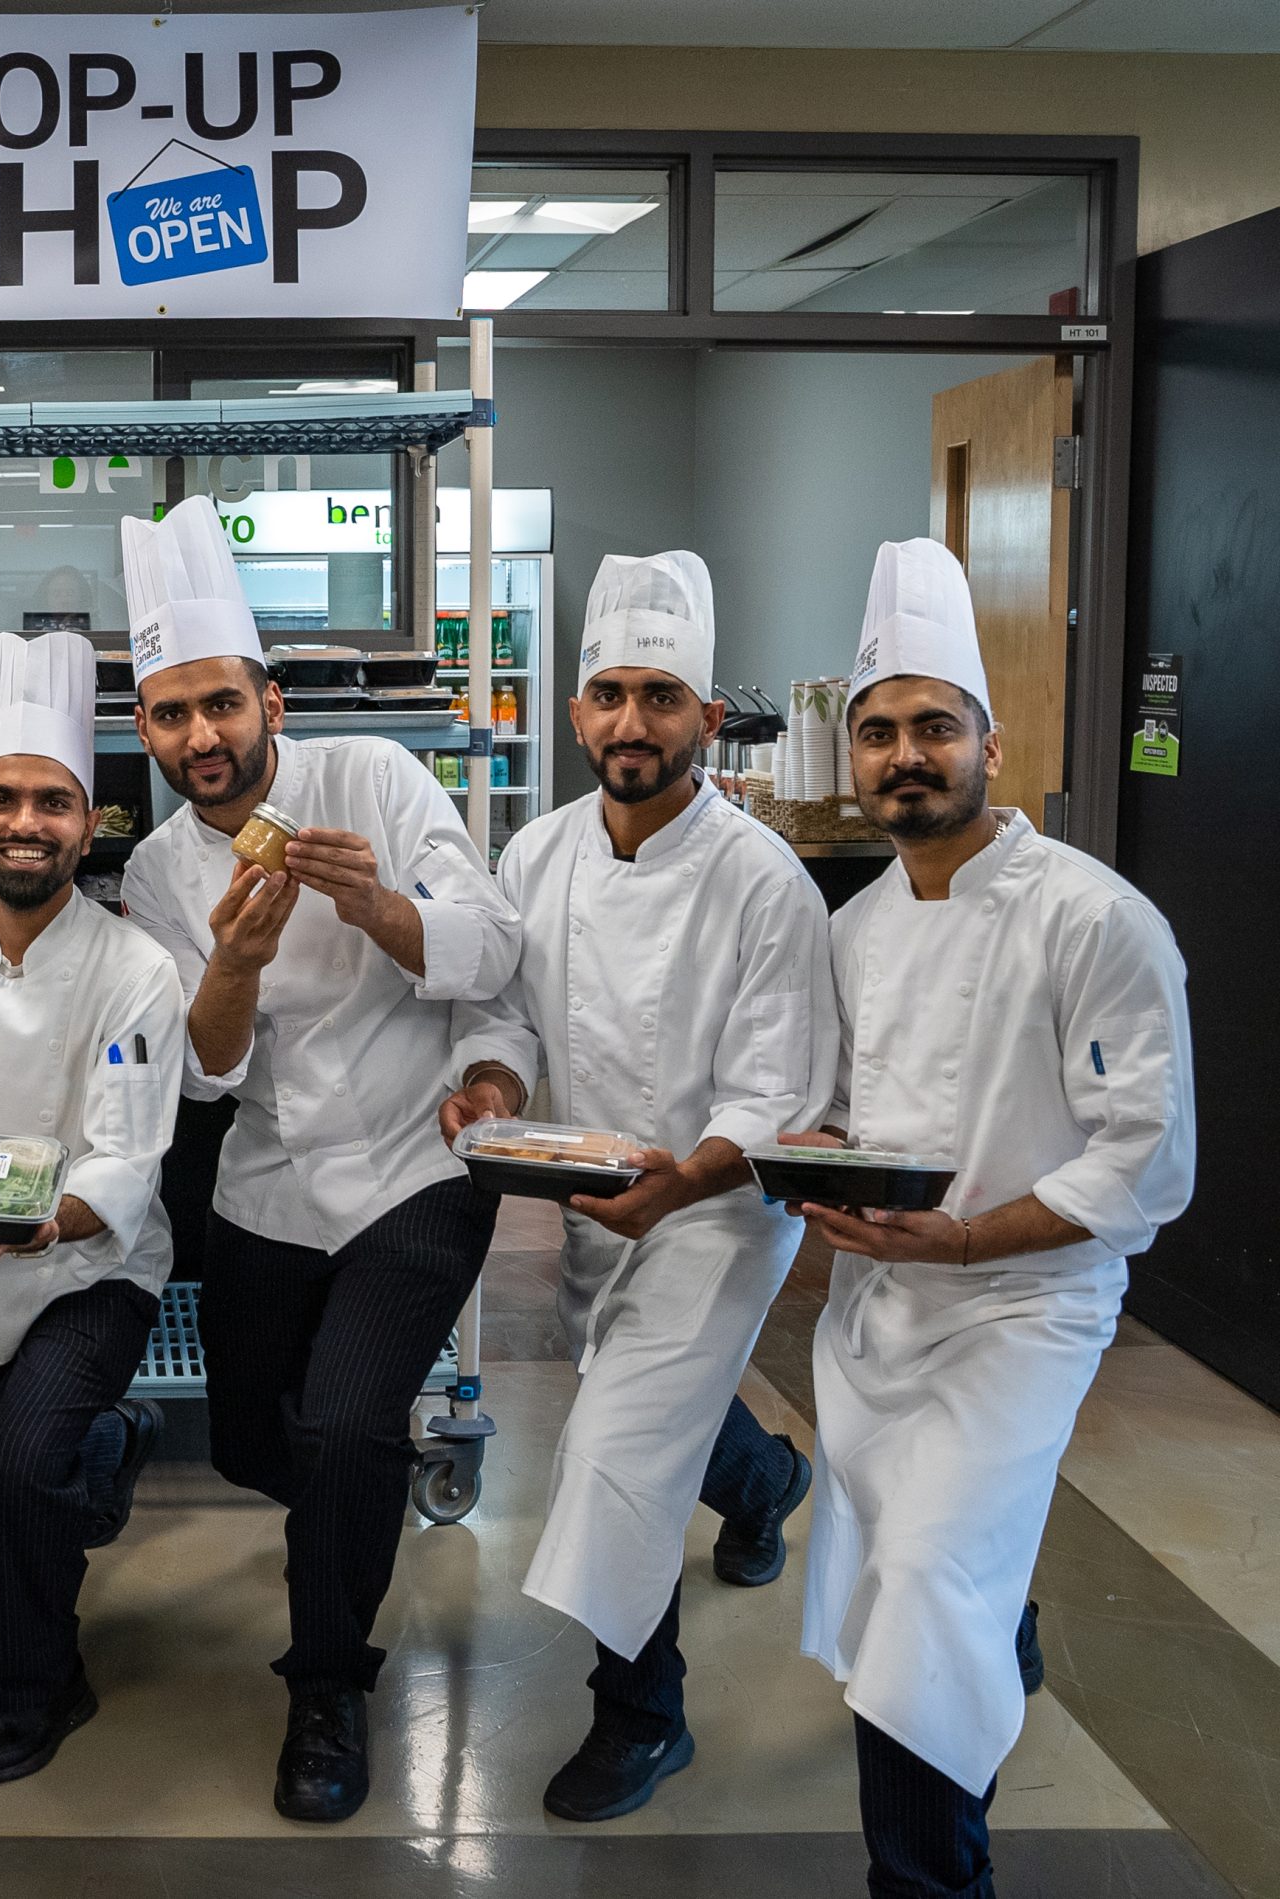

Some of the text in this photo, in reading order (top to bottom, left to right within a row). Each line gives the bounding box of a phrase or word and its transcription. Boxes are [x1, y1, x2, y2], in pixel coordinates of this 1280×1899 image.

[145, 193, 223, 221] We are
[128, 207, 253, 264] OPEN
[1069, 328, 1099, 337] HT 101
[133, 622, 160, 644] Niagara
[134, 634, 161, 656] College
[135, 645, 162, 668] Canada
[1142, 673, 1178, 693] INSPECTED
